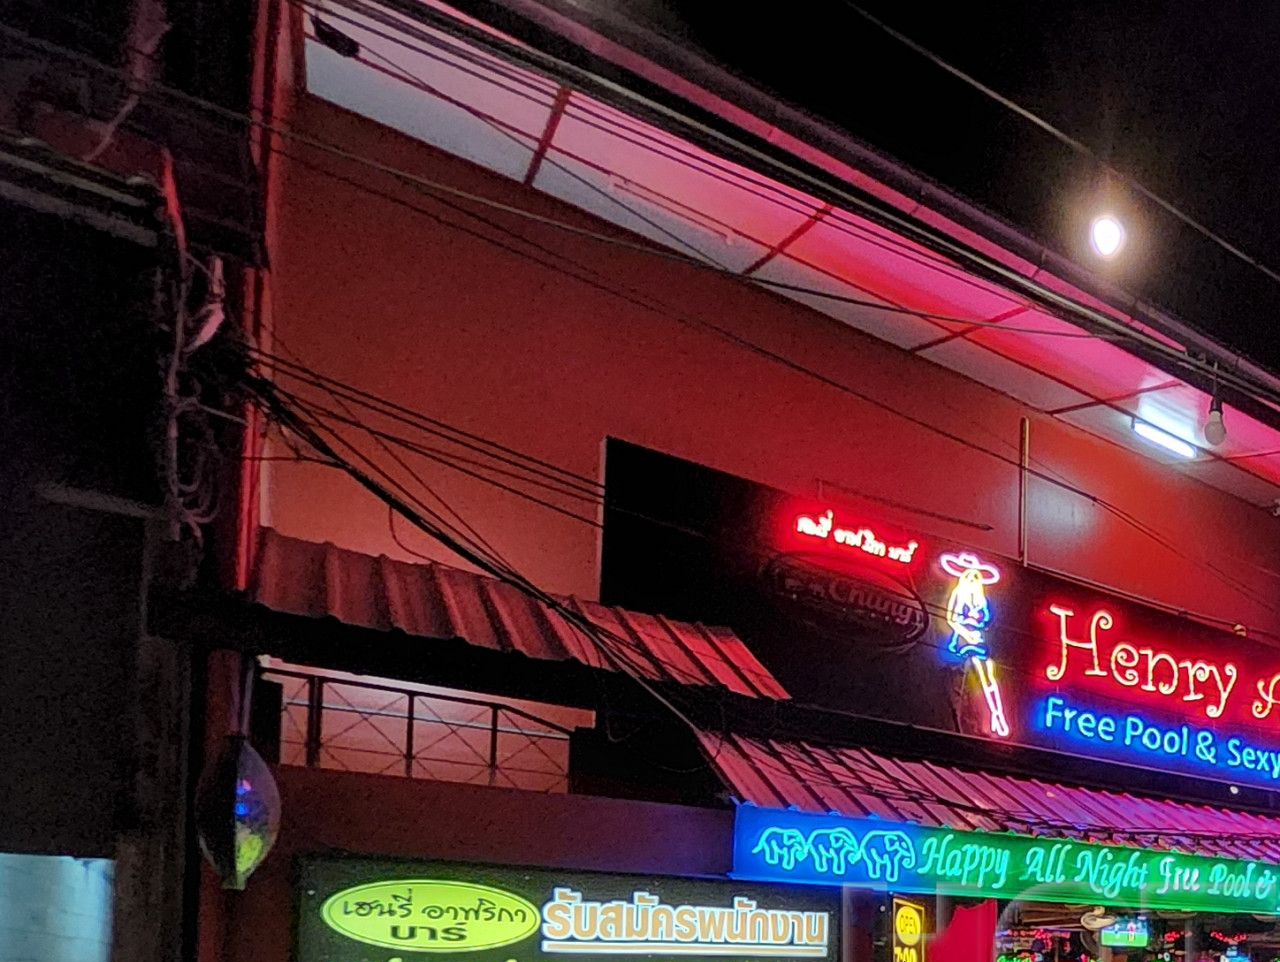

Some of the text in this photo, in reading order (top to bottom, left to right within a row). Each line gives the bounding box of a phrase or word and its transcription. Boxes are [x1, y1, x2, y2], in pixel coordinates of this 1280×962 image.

[1046, 604, 1237, 718] Henry
[1045, 697, 1116, 740] Free
[1125, 716, 1188, 755] Pool
[1196, 731, 1216, 764] &
[917, 836, 1010, 889] Happy
[1019, 843, 1068, 884] All
[1074, 850, 1149, 896] Night
[1156, 858, 1201, 896] Free
[1208, 861, 1256, 898] Pool
[391, 922, 467, 941] บาร์
[543, 888, 828, 944] รับสมัครพนักงาน
